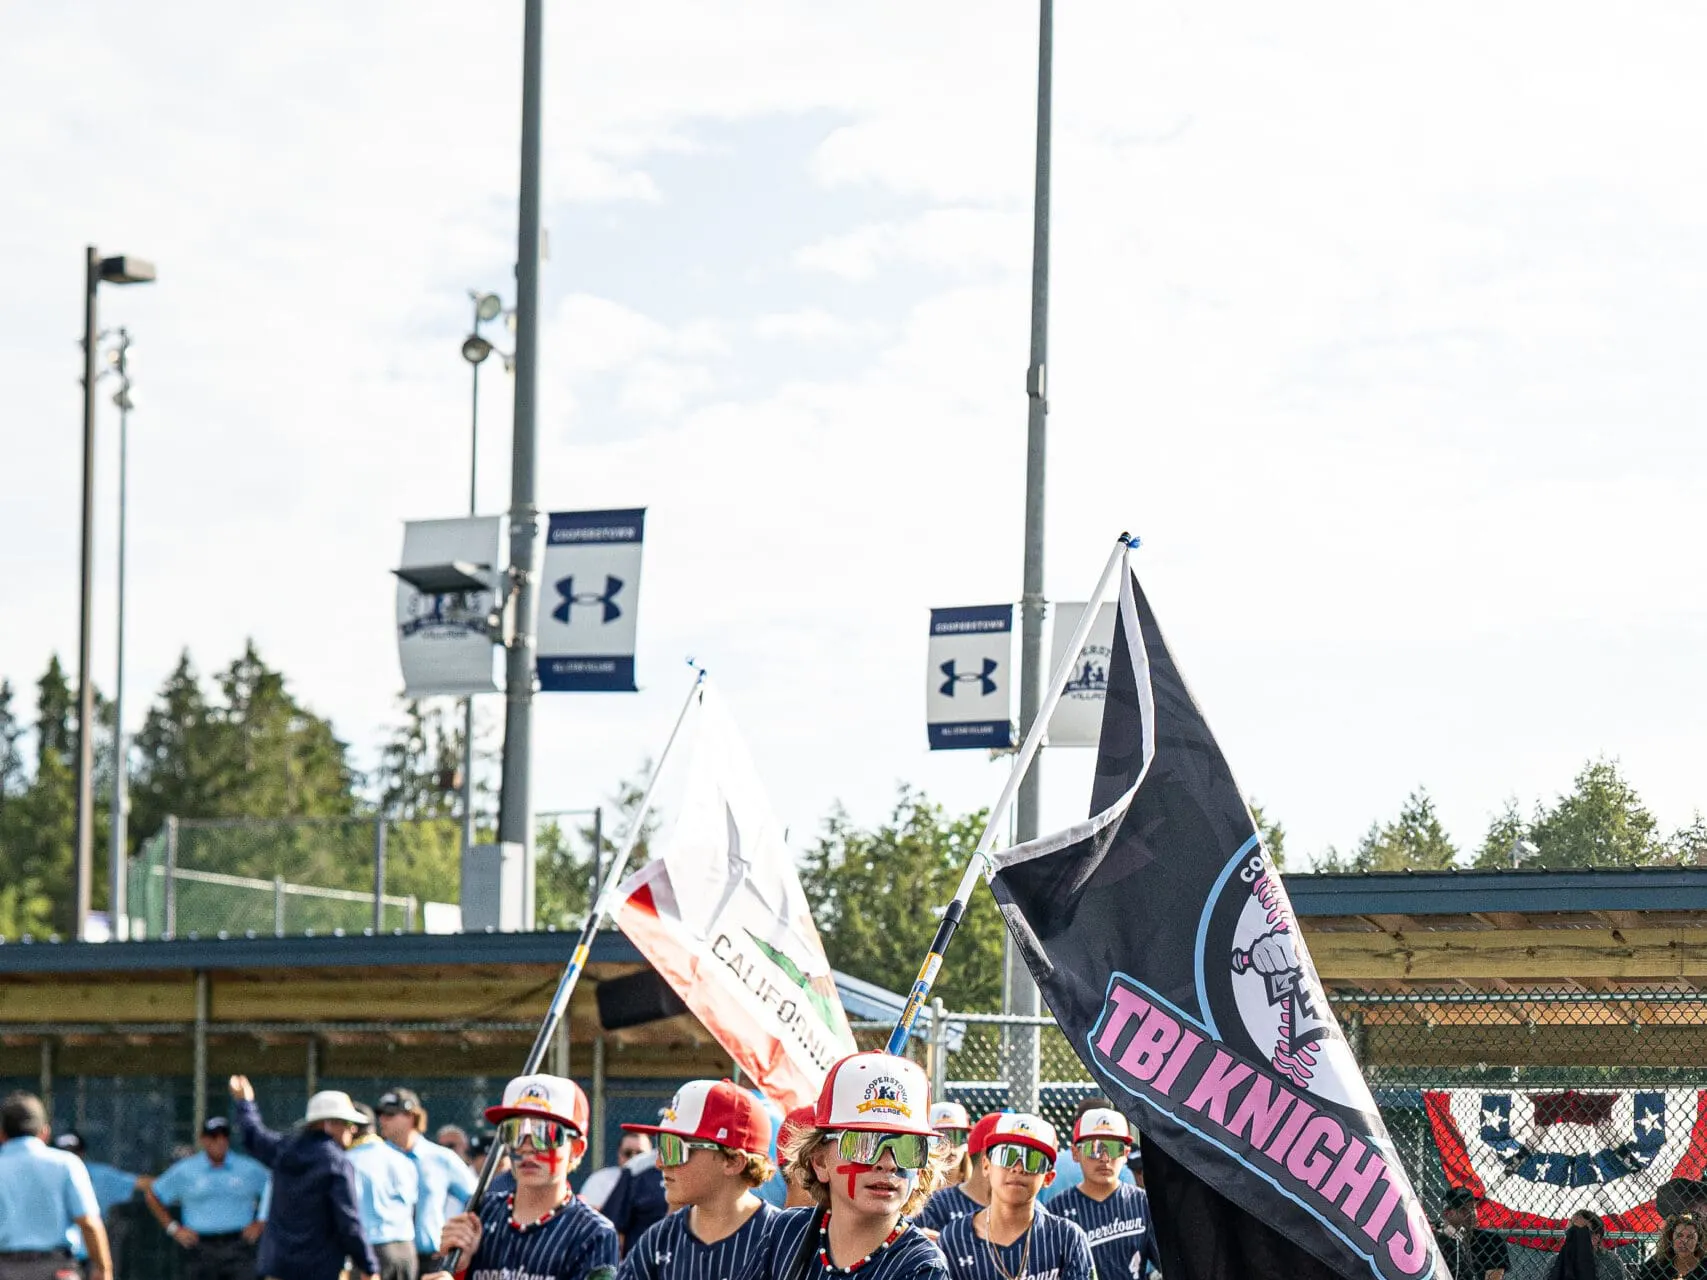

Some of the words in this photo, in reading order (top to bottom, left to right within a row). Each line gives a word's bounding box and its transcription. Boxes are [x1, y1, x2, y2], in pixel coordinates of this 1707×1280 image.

[1070, 692, 1106, 701] VILLAG
[864, 1076, 909, 1104] COOPERSTOWN
[1096, 984, 1204, 1097] TBI
[1182, 1048, 1430, 1276] KNIGHTS
[1087, 1217, 1142, 1242] perstown
[1128, 1250, 1142, 1280] 4
